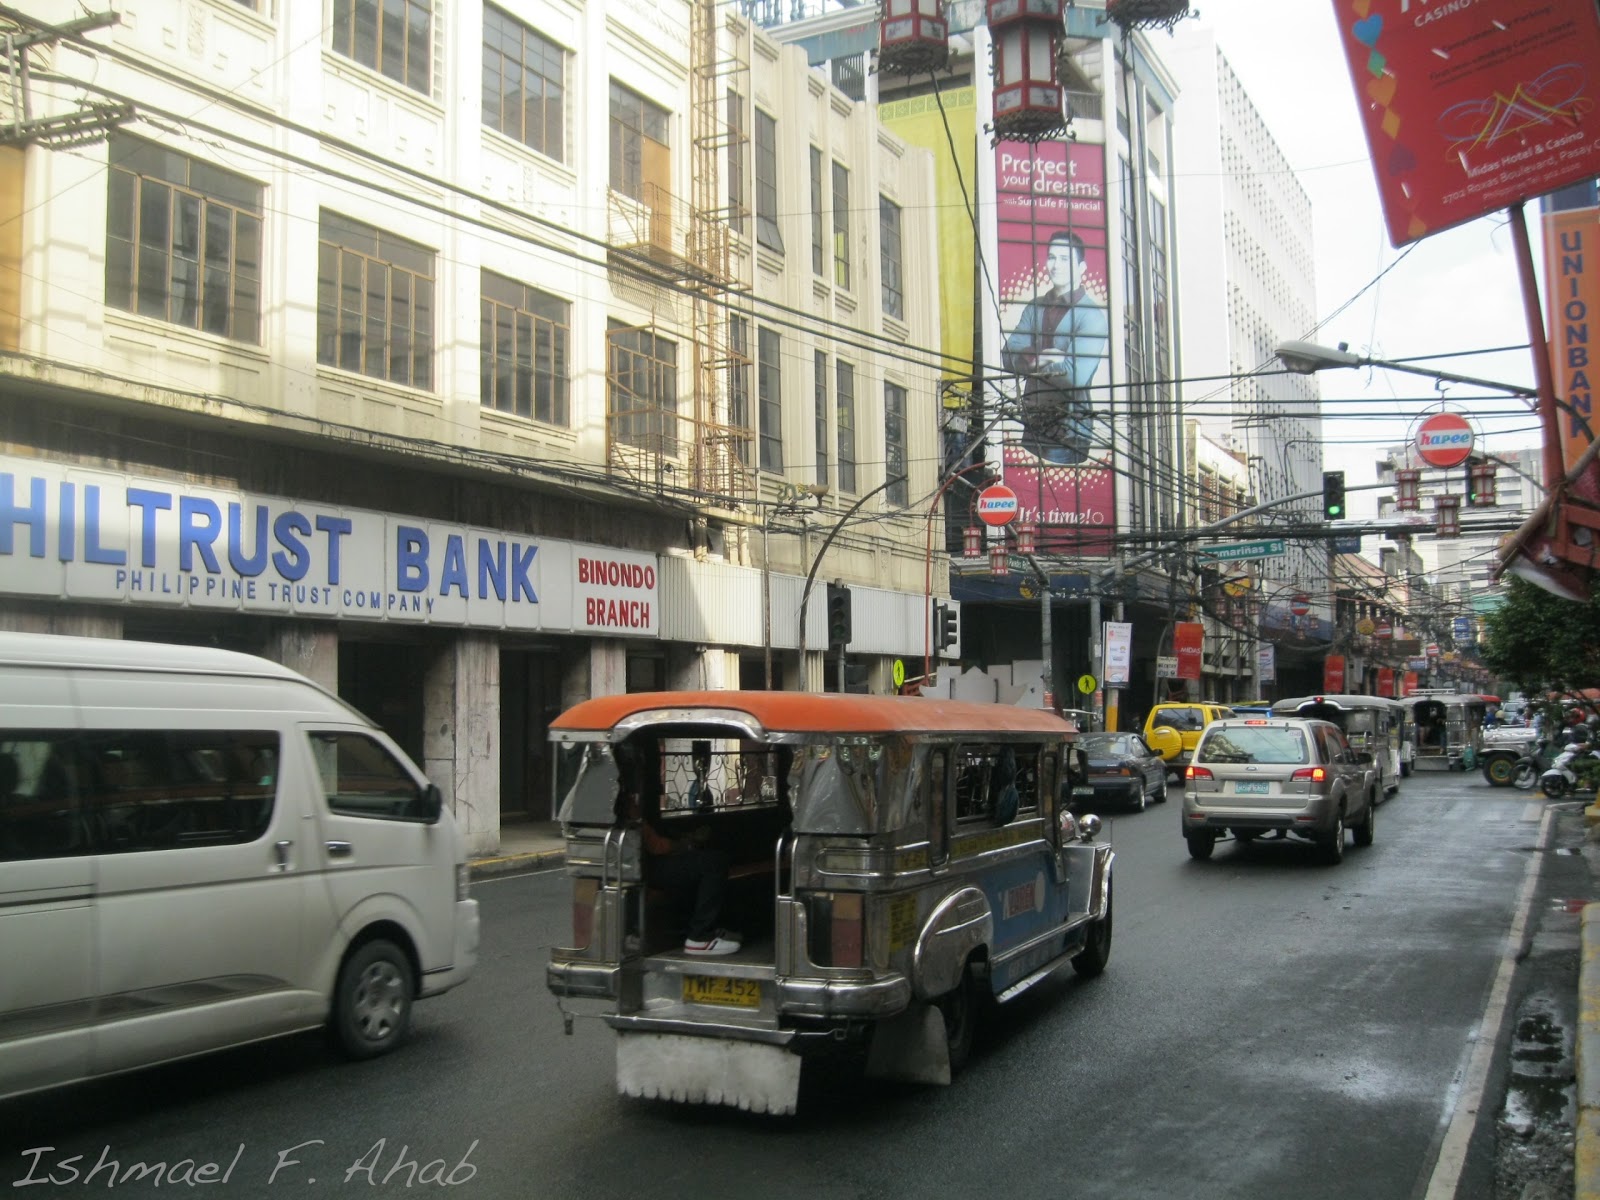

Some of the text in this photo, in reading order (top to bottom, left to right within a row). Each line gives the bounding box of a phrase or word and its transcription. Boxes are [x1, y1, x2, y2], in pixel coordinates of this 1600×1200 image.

[1414, 0, 1471, 27] CASINO
[1001, 153, 1077, 176] Protect
[1467, 176, 1499, 193] Roxas
[1560, 144, 1592, 161] Pasay
[1468, 131, 1584, 178] Midas Hotel & Casino
[1003, 171, 1100, 196] your dreams
[1017, 196, 1037, 206] Sun
[1039, 198, 1057, 208] Life
[1058, 199, 1101, 211] Financial
[1560, 230, 1593, 439] UNIONBANK
[1019, 506, 1091, 525] It's time!
[0, 472, 539, 604] HILTRUST BANK
[1198, 542, 1283, 560] mariñas St
[578, 557, 656, 590] BINONDO
[116, 569, 435, 615] PHILIPPINE TRUST COMPANY
[586, 597, 650, 629] BRANCH
